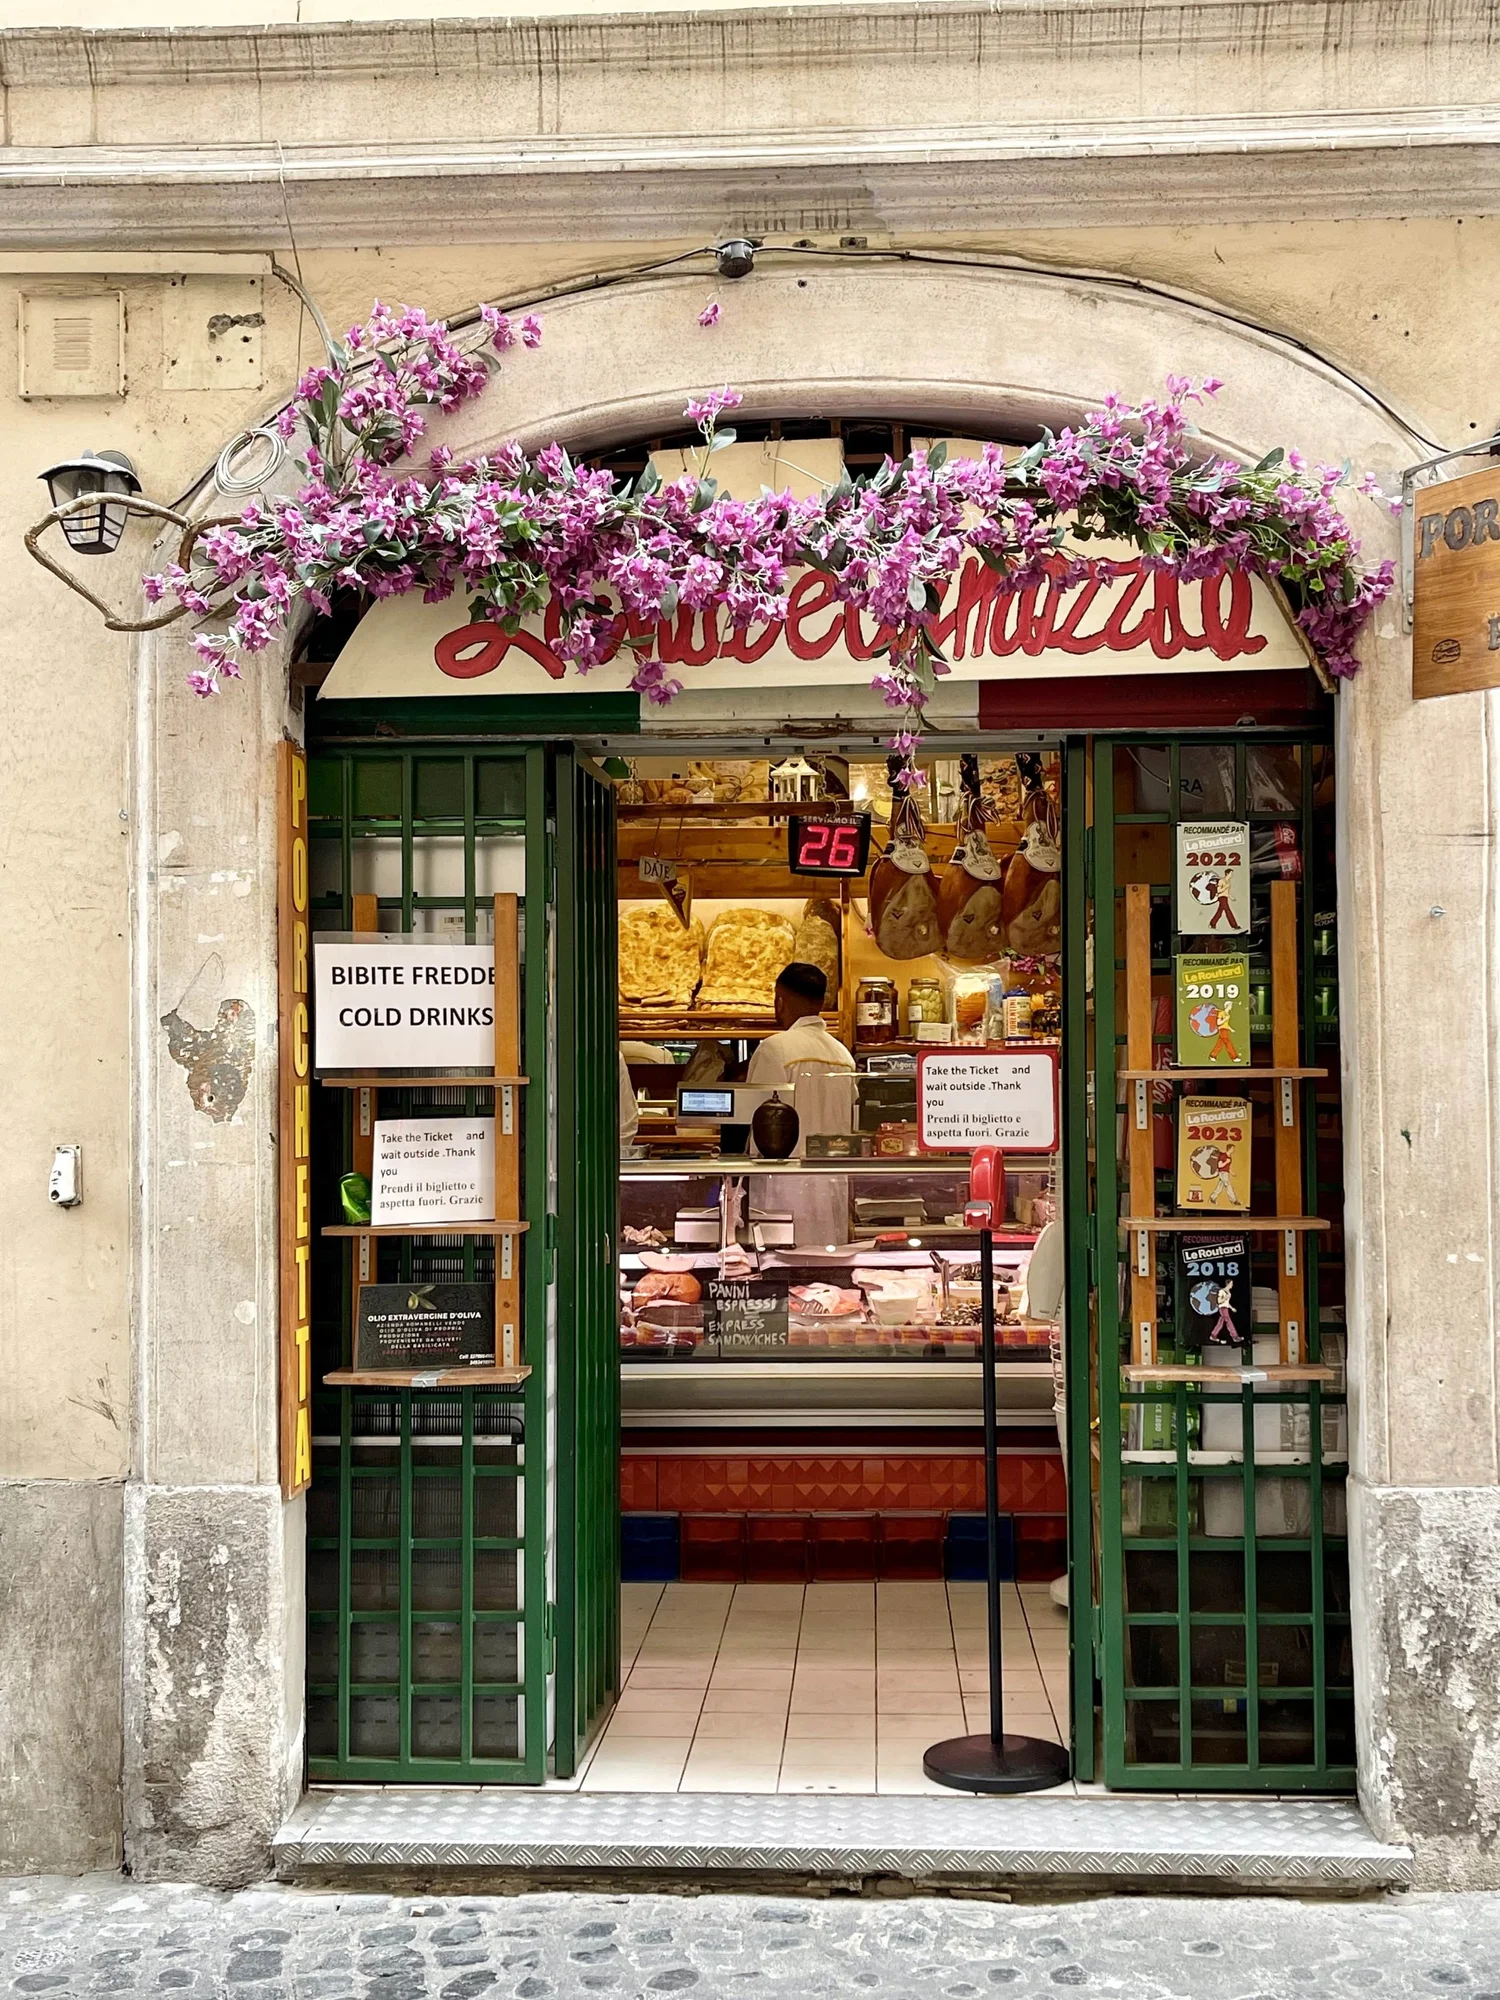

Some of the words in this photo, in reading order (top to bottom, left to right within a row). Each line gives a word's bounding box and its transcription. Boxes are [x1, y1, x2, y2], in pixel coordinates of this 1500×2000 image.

[803, 815, 848, 825] SERVIAMO
[849, 817, 857, 825] IL
[1183, 825, 1230, 834] RECOMMANDÉ
[1231, 826, 1245, 834] PAR
[799, 825, 858, 867] 26
[1185, 841, 1199, 851] Le
[1199, 833, 1243, 848] Routard
[1185, 852, 1241, 867] 2022
[643, 860, 670, 879] DAJE
[1183, 957, 1230, 966] RECOMMANDÉ
[1231, 958, 1244, 966] PAR
[331, 966, 404, 985] BIBITE
[1184, 973, 1198, 983] Le
[1198, 965, 1242, 979] Routard
[1186, 984, 1239, 999] 2019
[339, 1007, 401, 1027] COLD
[410, 1007, 494, 1026] DRINKS
[926, 1066, 948, 1075] Take
[951, 1066, 967, 1075] the
[969, 1065, 999, 1075] Ticket
[1012, 1065, 1031, 1075] and
[926, 1082, 947, 1091] wait
[949, 1081, 986, 1091] outside
[926, 1098, 944, 1109] you
[1185, 1099, 1232, 1109] RECOMMANDÉ
[1233, 1101, 1247, 1109] PAR
[291, 754, 311, 1487] PORCHETTA
[926, 1114, 960, 1124] Prendi
[962, 1114, 969, 1124] il
[972, 1113, 1013, 1125] biglietto
[1015, 1116, 1022, 1124] e
[1187, 1115, 1200, 1125] Le
[1200, 1108, 1245, 1123] Routard
[381, 1134, 403, 1144] Take
[405, 1133, 421, 1142] the
[424, 1132, 453, 1142] Ticket
[466, 1131, 485, 1141] and
[926, 1128, 962, 1140] aspetta
[965, 1127, 993, 1138] fuori.
[995, 1127, 1030, 1138] Grazie
[1187, 1126, 1242, 1142] 2023
[381, 1150, 401, 1160] wait
[403, 1149, 440, 1159] outside
[380, 1168, 398, 1178] you
[380, 1183, 413, 1194] Prendi
[416, 1183, 423, 1192] il
[426, 1182, 467, 1194] biglietto
[469, 1182, 476, 1190] e
[380, 1198, 415, 1211] aspetta
[418, 1196, 447, 1207] fuori.
[449, 1195, 484, 1206] Grazie
[1185, 1251, 1198, 1261] Le
[1199, 1243, 1242, 1259] Routard
[1187, 1262, 1239, 1276] 2018
[388, 1313, 448, 1321] EXTRAVERGINE
[449, 1311, 482, 1320] D'OLIVA
[708, 1319, 766, 1333] EXPRESS
[708, 1332, 787, 1346] SANDWICHES
